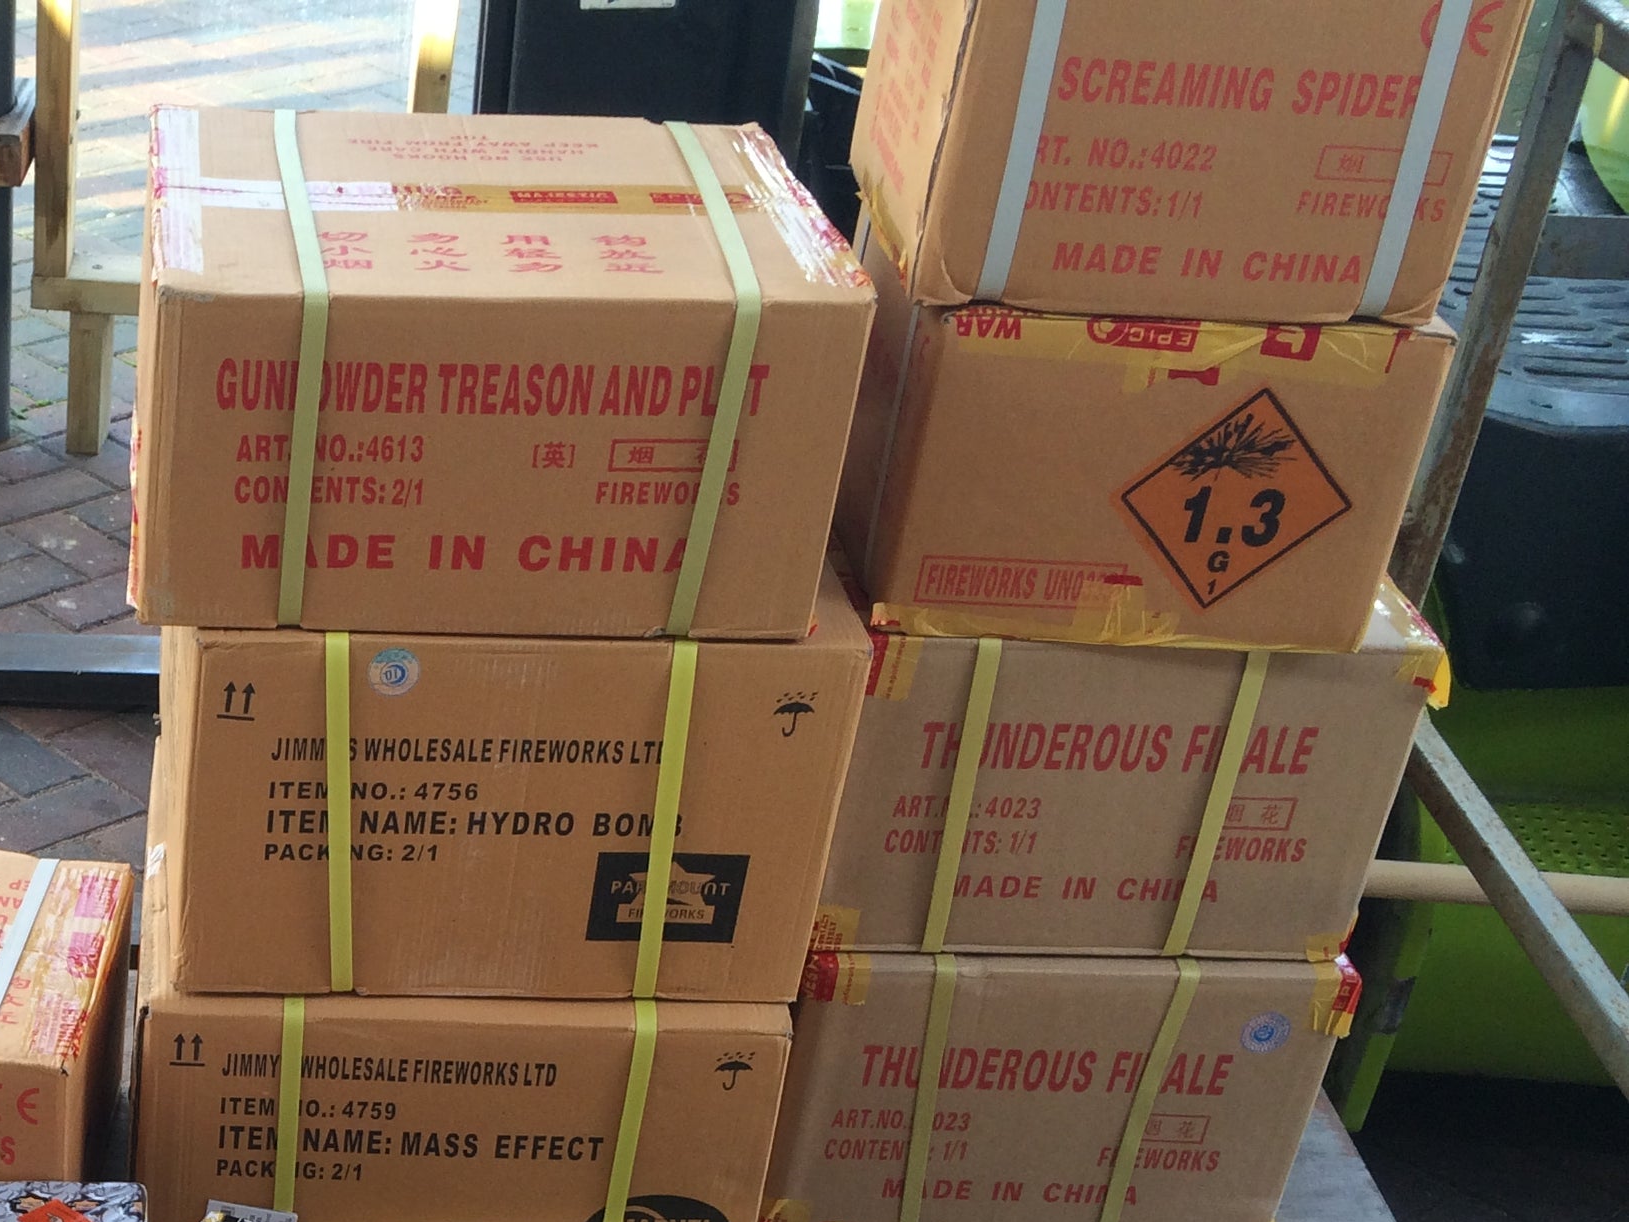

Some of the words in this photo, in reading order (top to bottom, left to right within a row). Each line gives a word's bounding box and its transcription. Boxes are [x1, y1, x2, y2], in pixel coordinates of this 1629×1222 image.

[1058, 57, 1274, 112] SCREAMING
[1088, 137, 1217, 173] NO.:4022
[1296, 189, 1445, 223] FIREWOKS
[1052, 242, 1162, 276] MADE
[1181, 248, 1224, 280] IN
[1242, 252, 1362, 285] CHINA
[216, 358, 428, 414] GUNOWDER
[437, 363, 594, 416] TREASON
[599, 365, 672, 416] AND
[678, 365, 770, 416] PLT
[315, 434, 424, 463] NO.:4613
[1182, 484, 1287, 547] 1.3
[428, 535, 486, 570] IN
[518, 535, 689, 573] CHINA
[1207, 550, 1229, 572] G
[925, 563, 1037, 599] FIREWORKS
[364, 738, 493, 763] WHOLESALE
[498, 739, 624, 764] FIREWORKS
[1181, 725, 1320, 774] FIALE
[269, 782, 329, 799] ITEM
[415, 783, 478, 800] 4756
[360, 811, 457, 835] NAME:
[467, 812, 574, 836] HYDRO
[264, 844, 393, 861] PACKNG:
[401, 845, 438, 862] 2/1
[1062, 877, 1097, 900] IN
[301, 1055, 408, 1082] WHOLESALE
[413, 1060, 519, 1087] FIREWORKS
[524, 1063, 558, 1087] LTD
[1105, 1051, 1234, 1096] FIALE
[220, 1097, 275, 1116] ITEM
[342, 1101, 397, 1121] 4759
[303, 1127, 392, 1154] NAME:
[400, 1132, 478, 1158] MASS
[494, 1135, 604, 1161] EFFECT
[331, 1163, 363, 1182] 2/1
[881, 1178, 973, 1200] MDE
[991, 1181, 1024, 1201] IN
